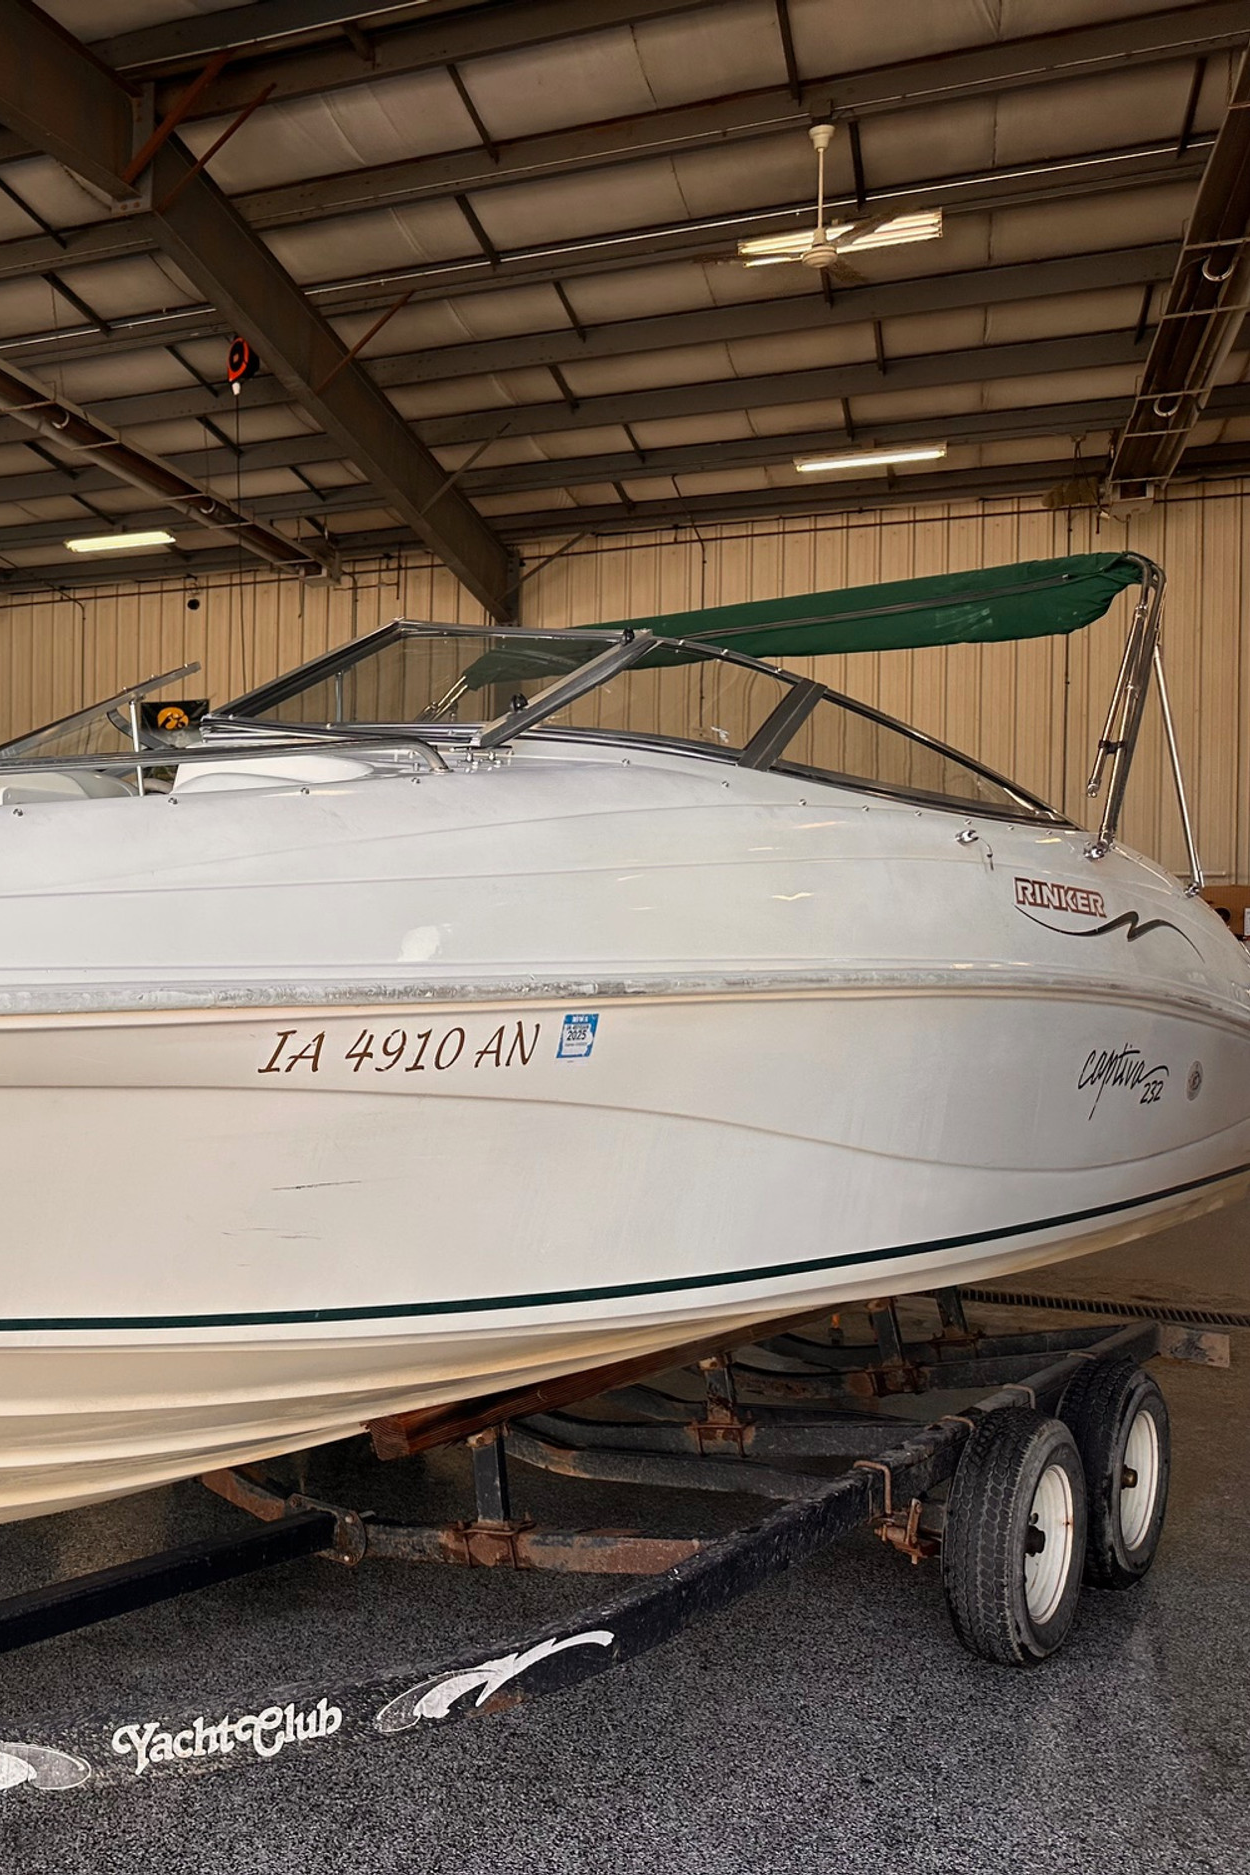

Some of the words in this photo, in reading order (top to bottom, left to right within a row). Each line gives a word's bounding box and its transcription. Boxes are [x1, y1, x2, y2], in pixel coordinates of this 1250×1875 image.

[1014, 877, 1107, 918] RINKER
[258, 1029, 326, 1074] IA
[344, 1027, 466, 1073] 4910
[473, 1020, 541, 1069] AN
[566, 1029, 587, 1041] 2025
[1140, 1081, 1164, 1105] 232
[111, 1717, 236, 1775] Yacht
[234, 1698, 343, 1757] Club
